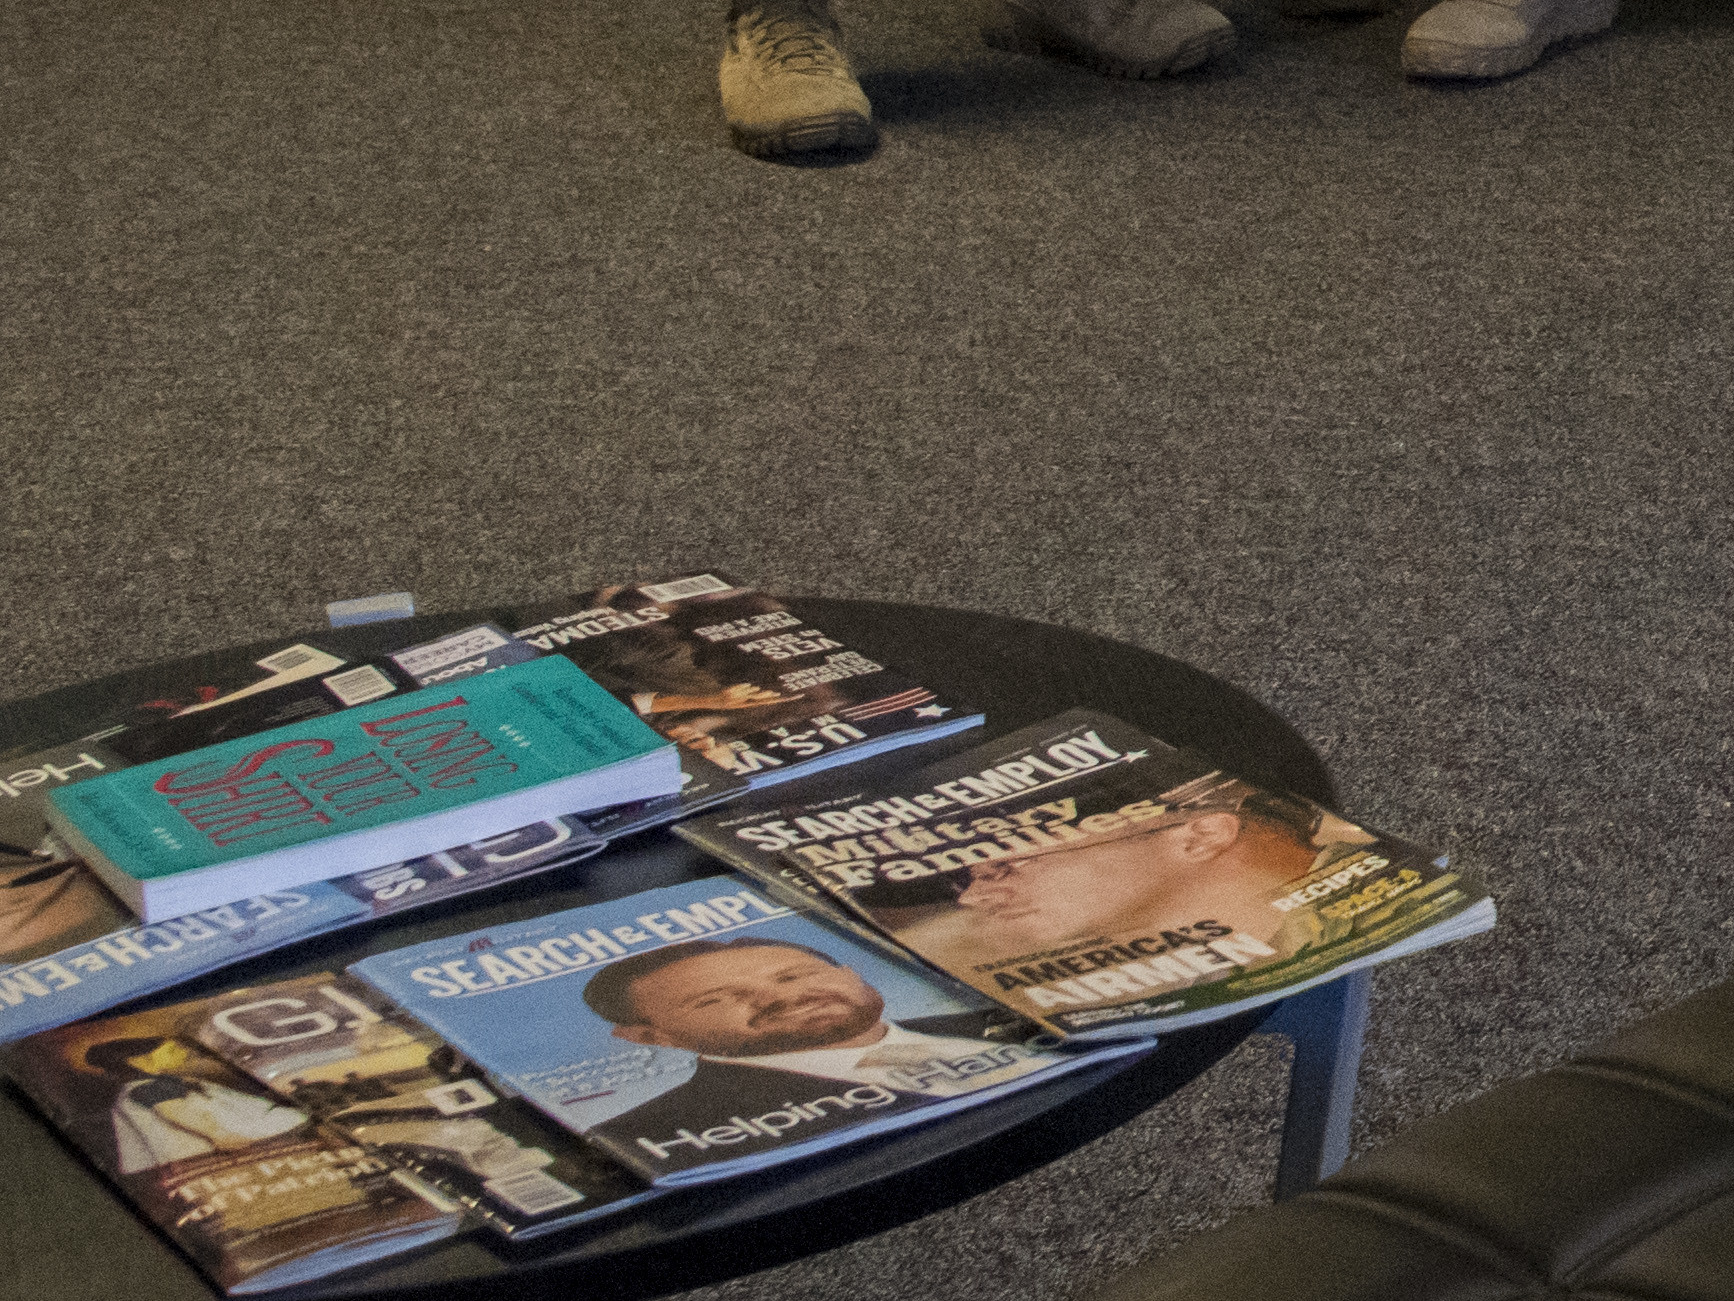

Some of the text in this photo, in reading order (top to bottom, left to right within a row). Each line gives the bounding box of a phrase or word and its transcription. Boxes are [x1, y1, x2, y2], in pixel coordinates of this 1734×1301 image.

[526, 605, 668, 651] STEDMA
[360, 695, 518, 791] LOSING
[154, 739, 335, 848] SHIRT
[300, 750, 421, 817] YOUR
[797, 797, 1079, 868] Military
[826, 798, 1167, 891] Families
[1271, 855, 1391, 914] RECIPES
[992, 918, 1234, 992] AMERICA'S
[1023, 933, 1277, 1010] AIRMEN
[893, 1043, 1033, 1090] Han
[637, 1082, 898, 1159] Helping
